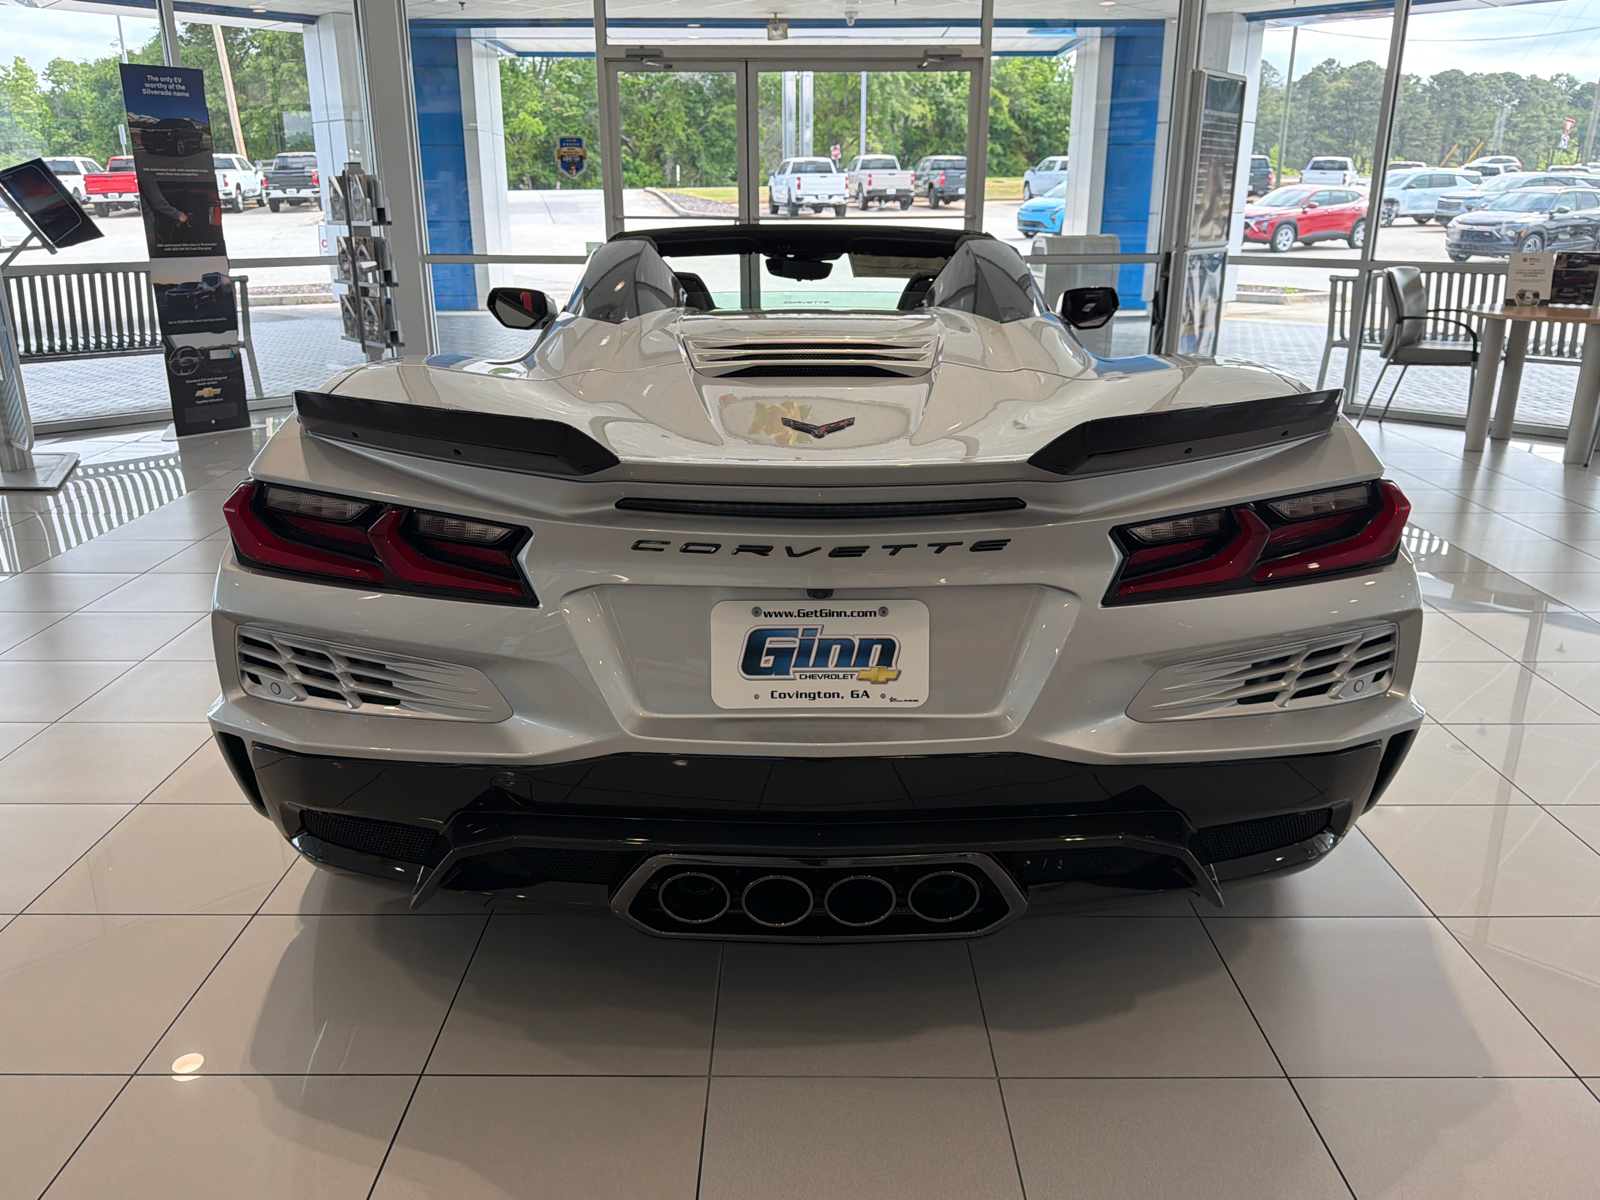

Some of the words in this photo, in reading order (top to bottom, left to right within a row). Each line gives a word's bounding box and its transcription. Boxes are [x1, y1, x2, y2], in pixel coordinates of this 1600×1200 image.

[630, 538, 1012, 558] CORVETTE
[763, 608, 877, 618] www.GetGinn.com
[738, 625, 902, 681] Ginn
[770, 690, 845, 701] Covington,
[850, 690, 870, 699] GA
